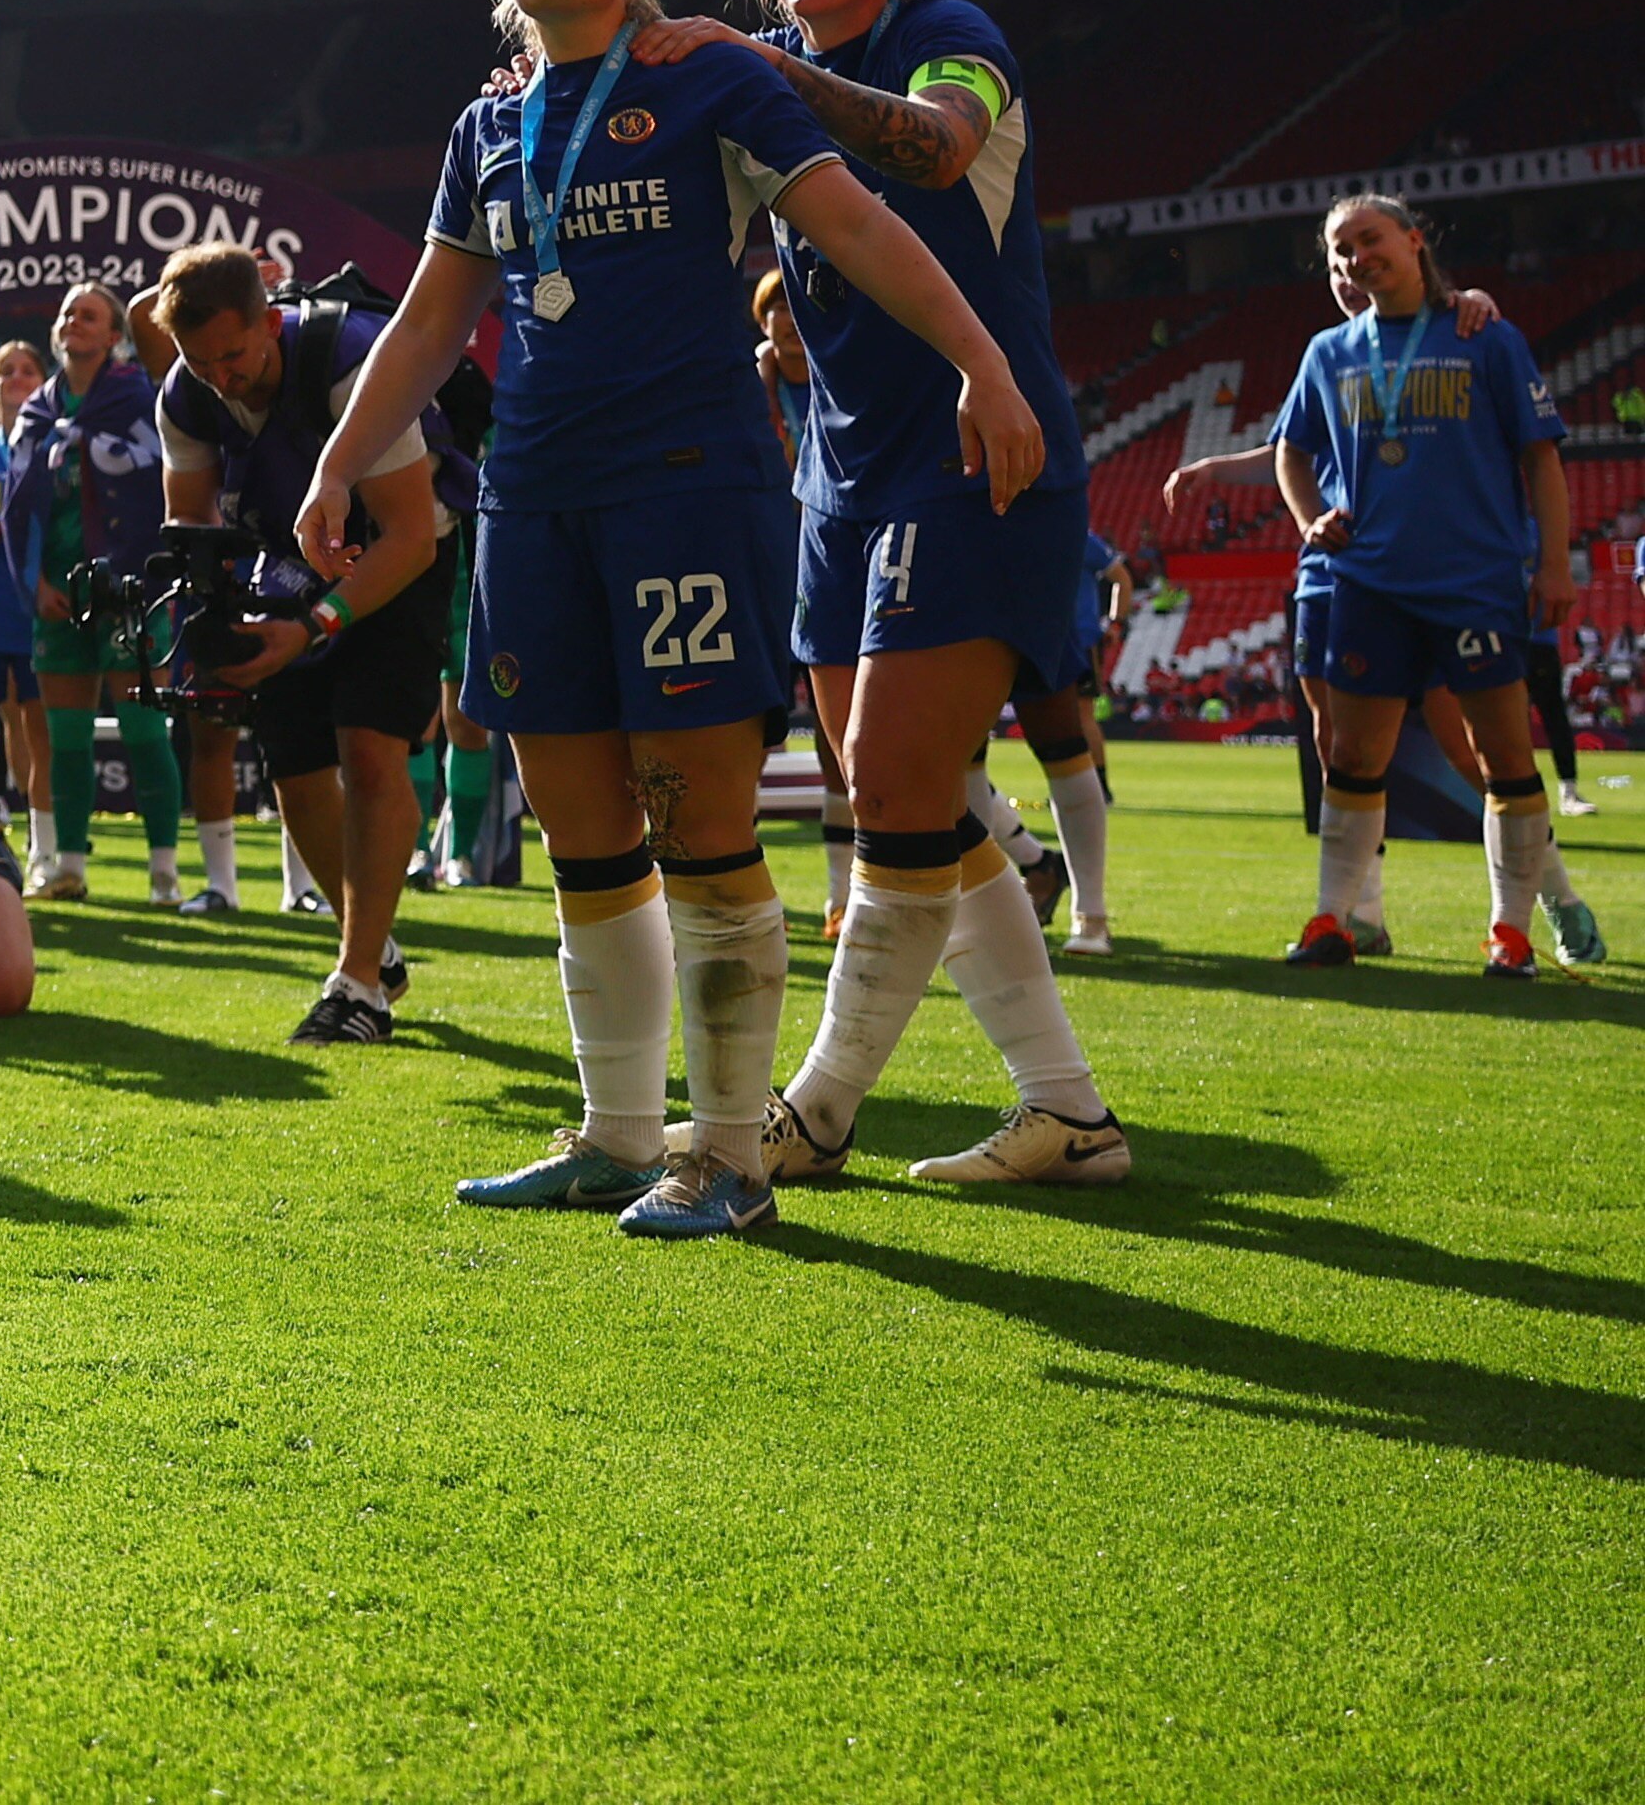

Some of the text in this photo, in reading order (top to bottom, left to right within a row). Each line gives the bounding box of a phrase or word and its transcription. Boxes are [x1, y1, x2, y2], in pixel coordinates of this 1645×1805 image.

[575, 97, 600, 140] BARCLAYS
[108, 158, 176, 186] SUPER
[180, 168, 263, 207] LEAGUE
[881, 523, 918, 602] 4
[635, 572, 735, 668] 22
